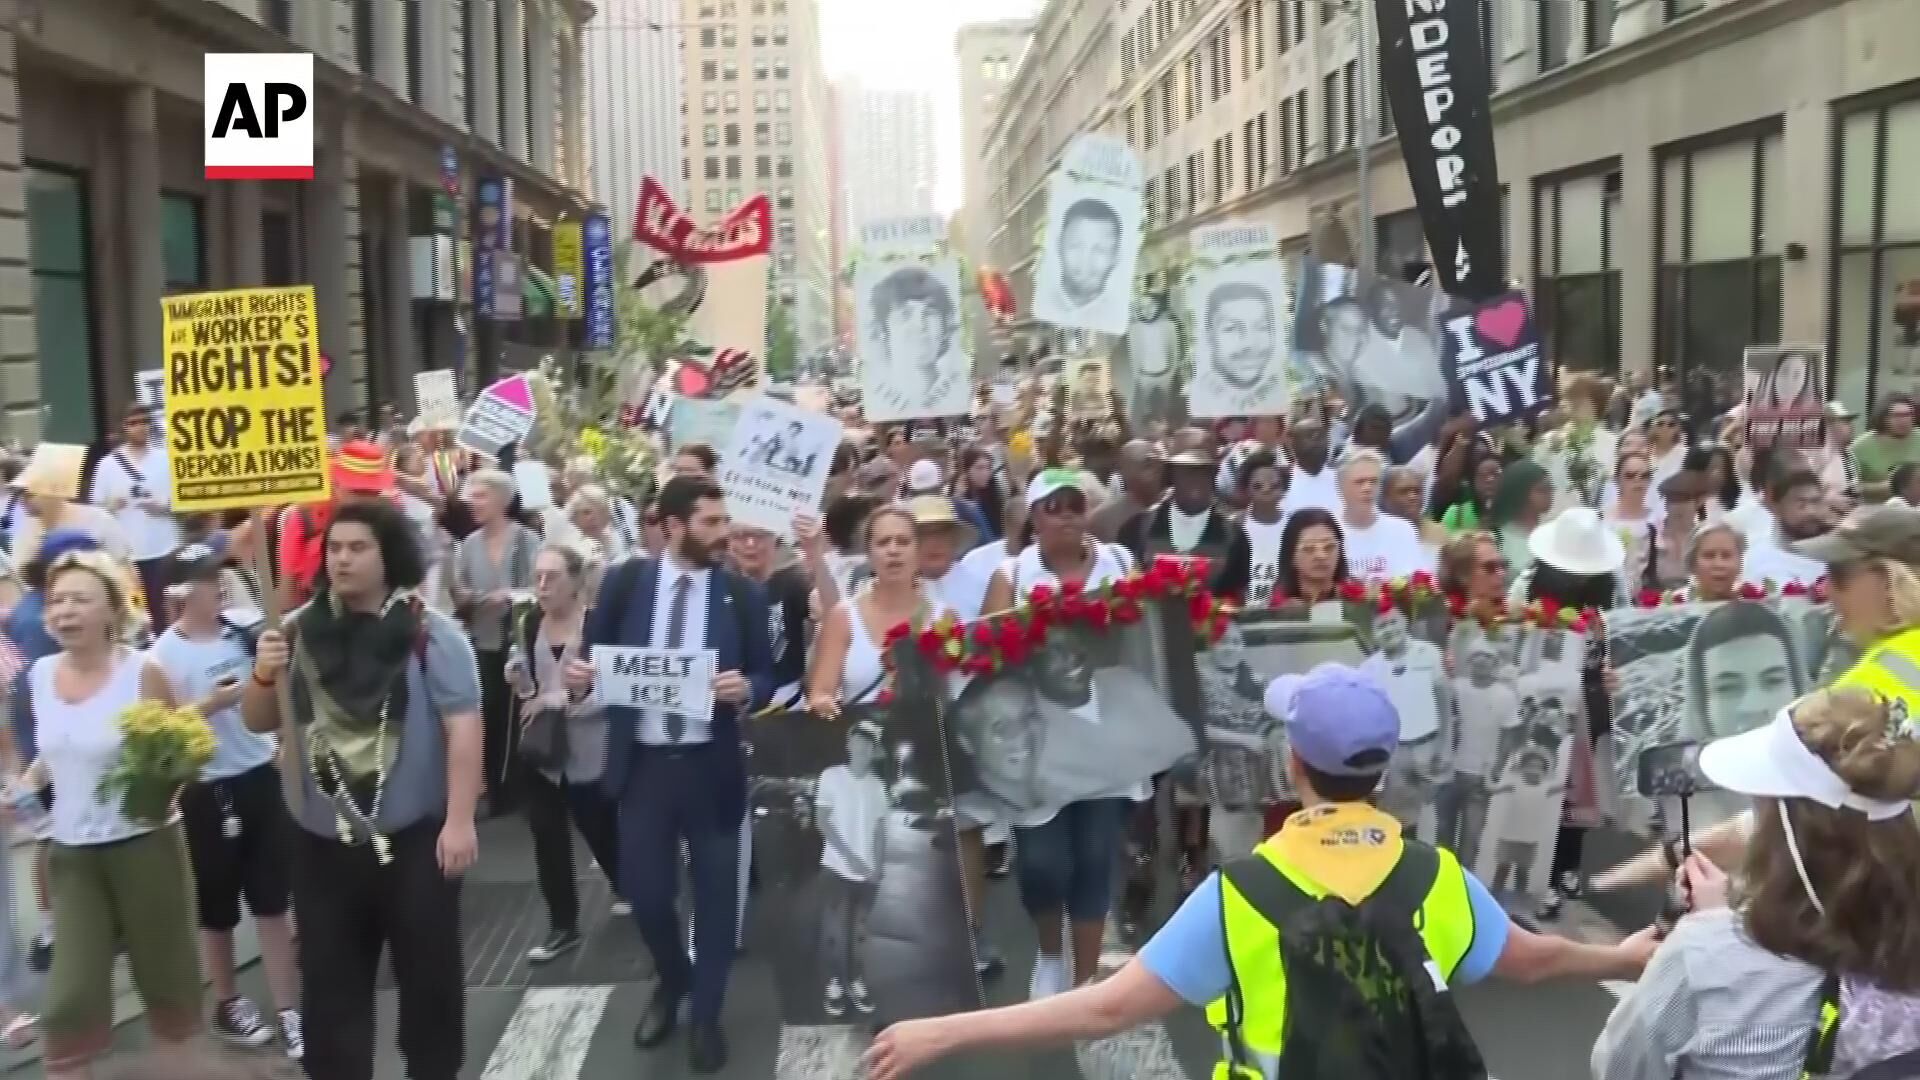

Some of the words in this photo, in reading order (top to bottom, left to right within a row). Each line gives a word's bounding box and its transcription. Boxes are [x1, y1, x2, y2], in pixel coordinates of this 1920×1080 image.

[248, 293, 307, 315] RIGHTS
[192, 314, 310, 346] WORKER'S
[171, 343, 312, 395] RIGHTS!
[1463, 357, 1540, 421] NY
[171, 405, 251, 451] STOP
[259, 406, 318, 445] THE
[174, 446, 320, 479] DEPORTATIONS!
[613, 654, 696, 677] MELT
[630, 684, 682, 707] ICE
